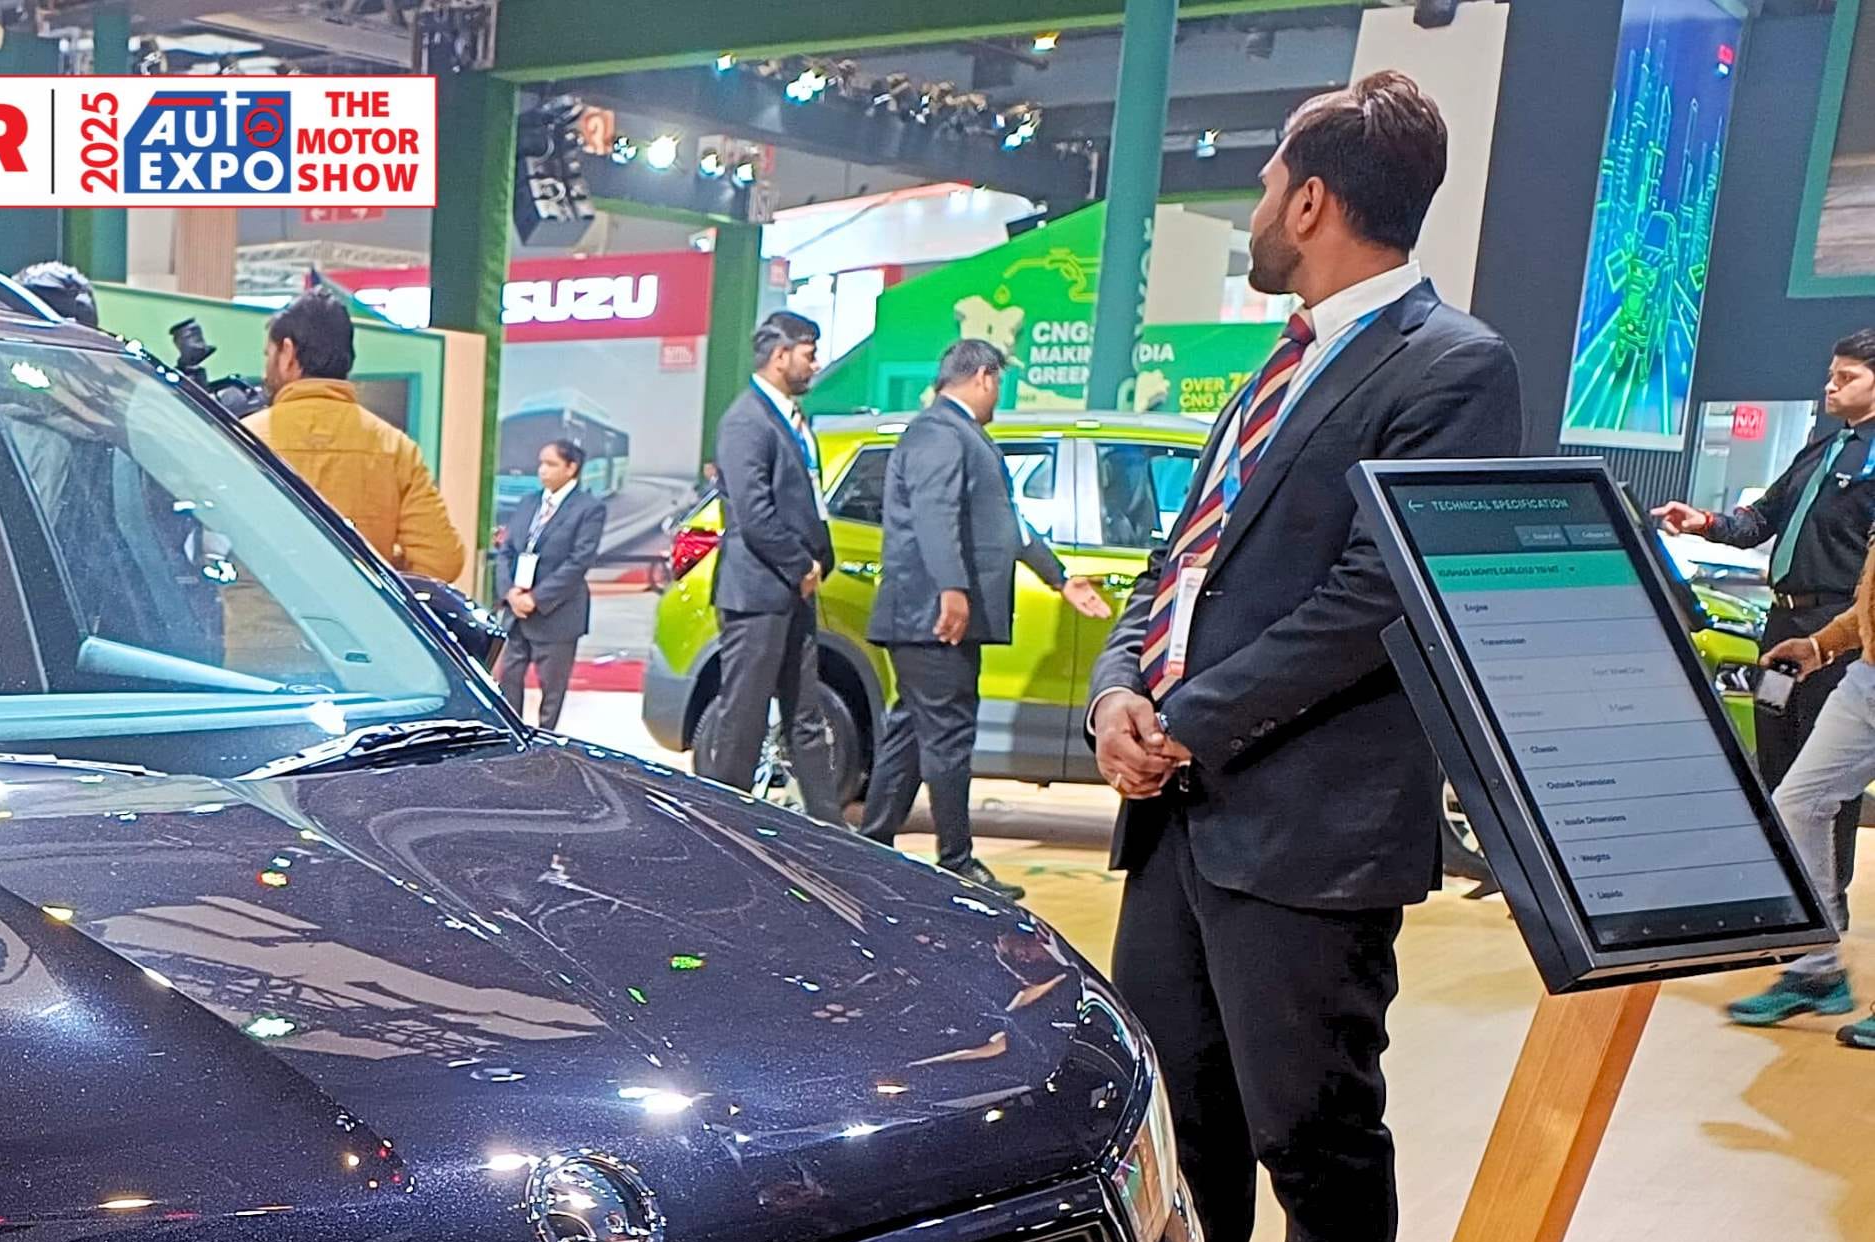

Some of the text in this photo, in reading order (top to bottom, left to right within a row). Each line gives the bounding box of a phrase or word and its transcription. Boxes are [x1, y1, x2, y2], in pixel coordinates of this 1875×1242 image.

[501, 273, 659, 324] SUZU
[1180, 376, 1226, 392] OVER
[1431, 499, 1491, 512] TECHNICAL
